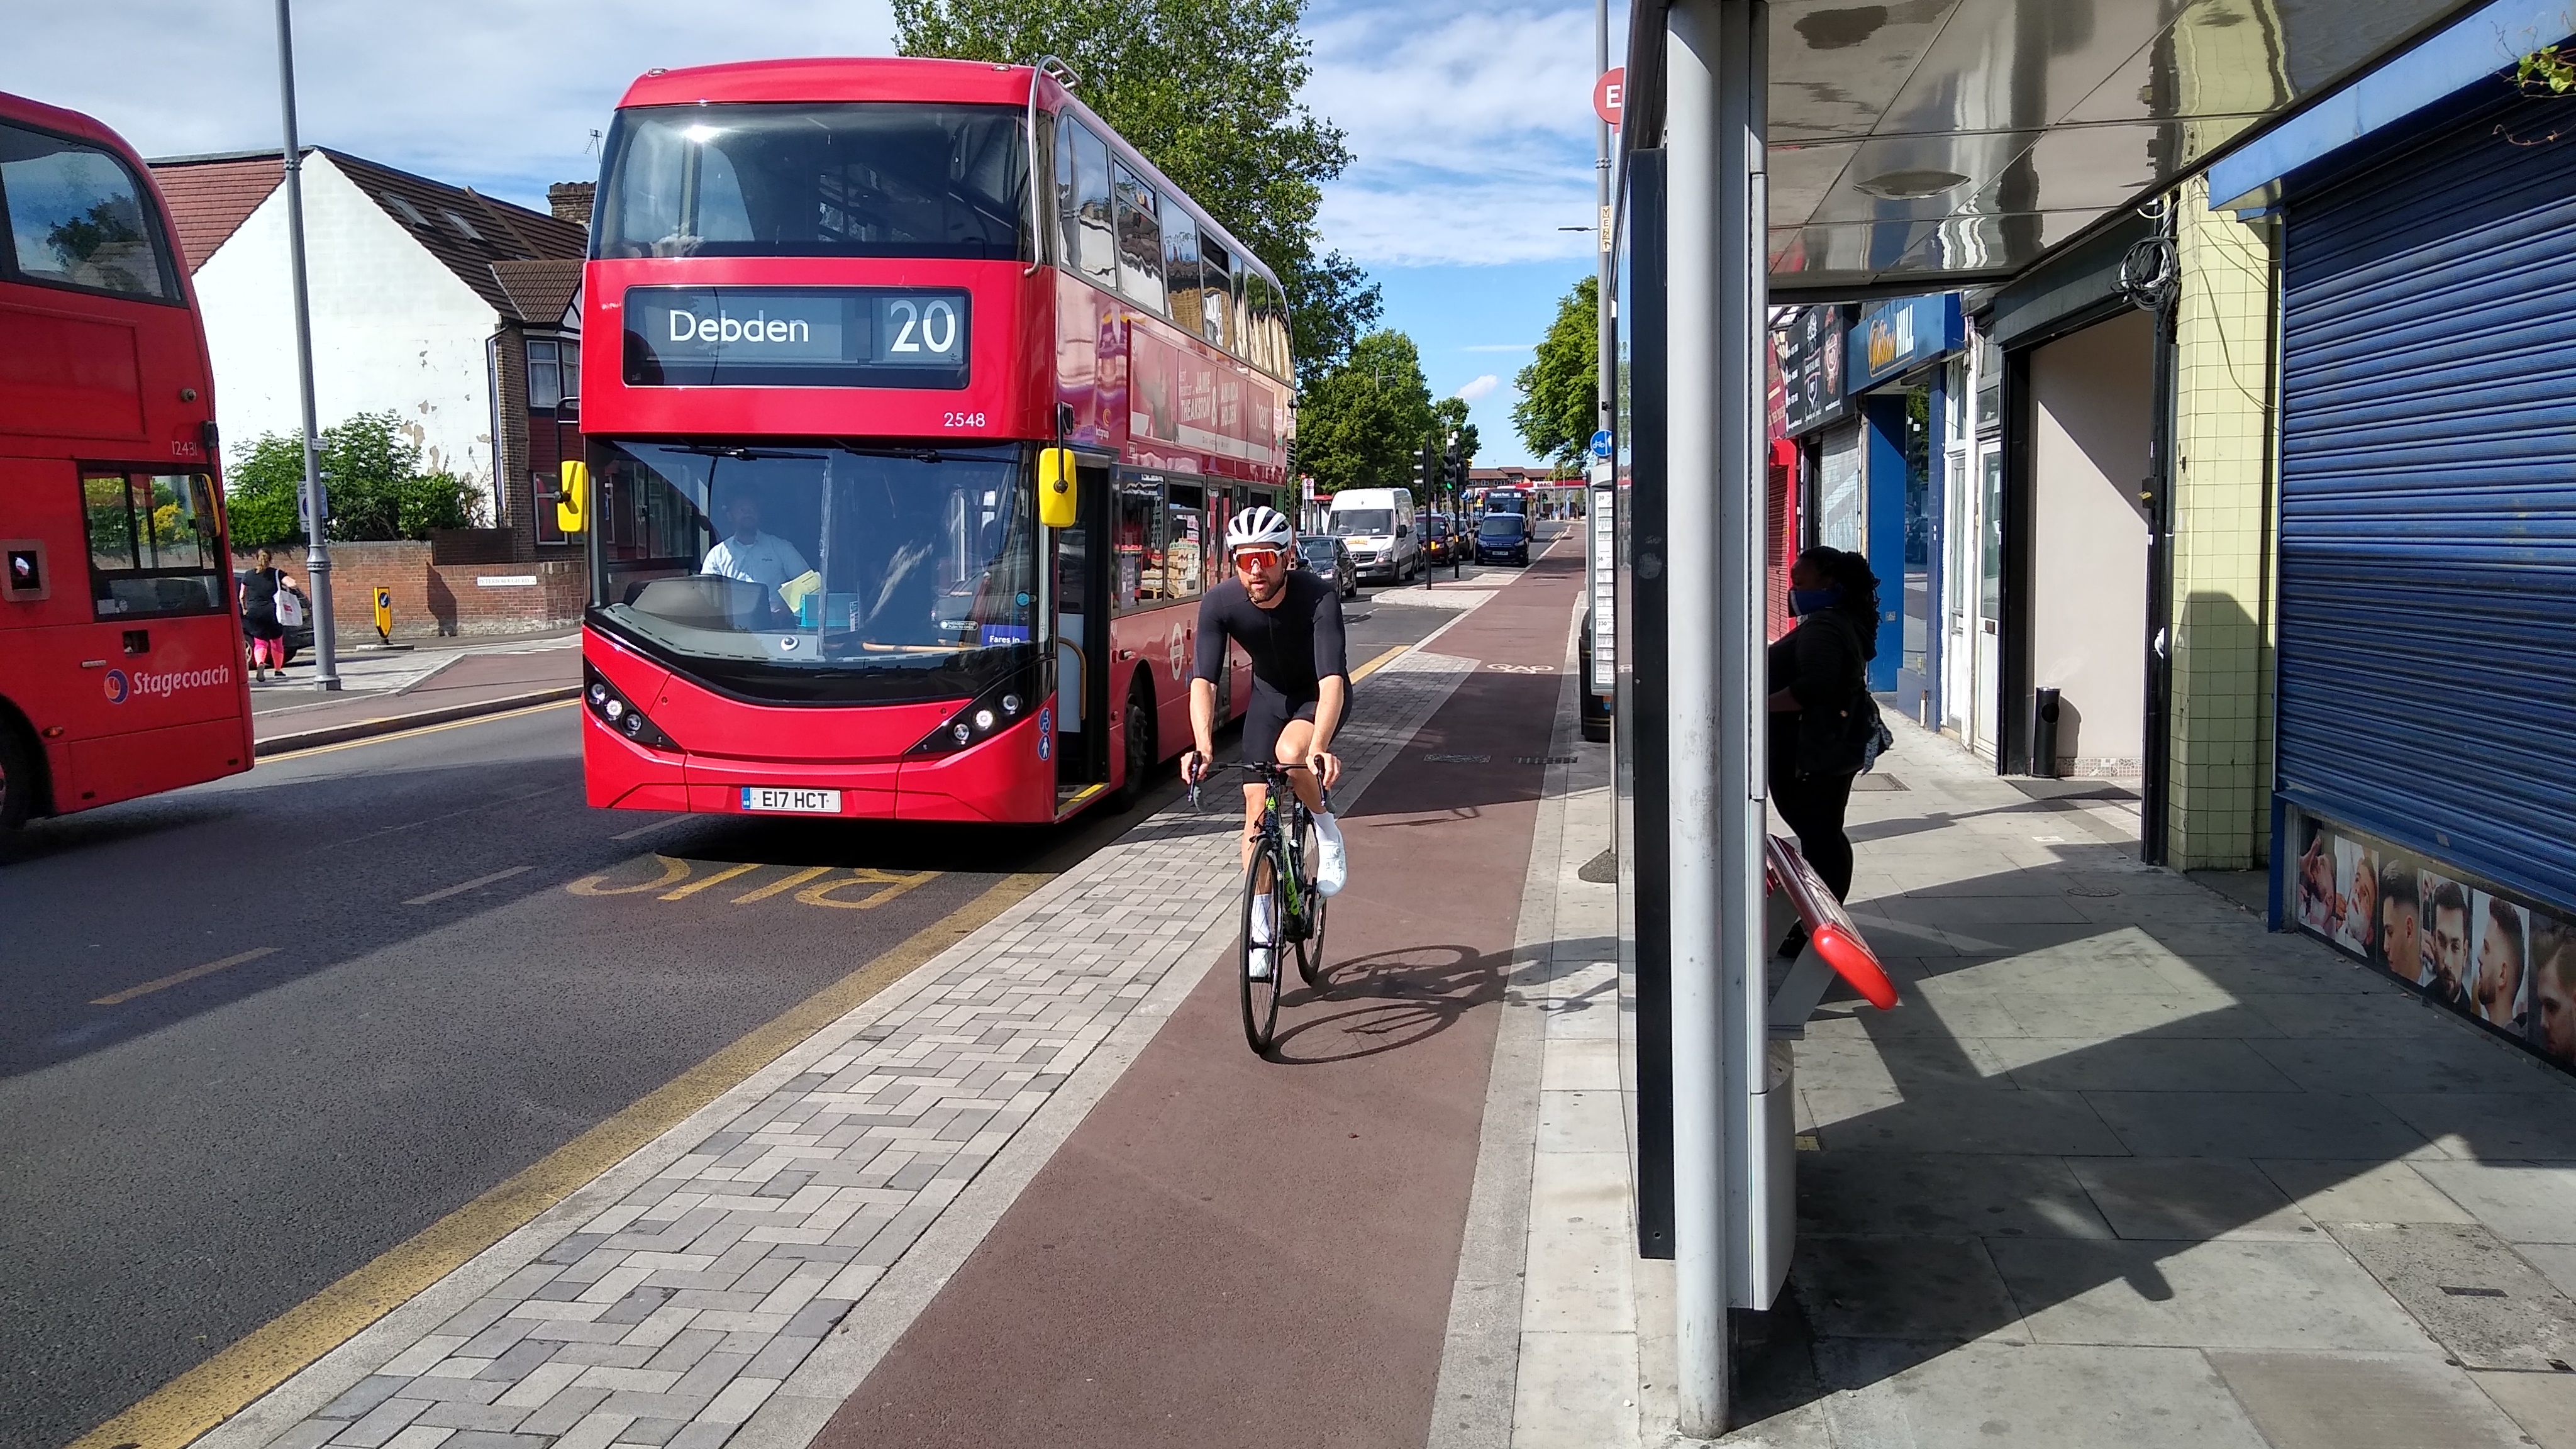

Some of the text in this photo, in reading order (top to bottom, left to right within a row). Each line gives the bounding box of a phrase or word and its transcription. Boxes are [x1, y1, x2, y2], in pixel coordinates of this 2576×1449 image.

[1606, 84, 1622, 108] E
[669, 299, 957, 353] Debden 20
[1896, 304, 1914, 358] HILL
[1196, 371, 1211, 394] JAMIE
[943, 413, 986, 427] 2548
[1180, 396, 1211, 422] THEAKSTON
[1256, 396, 1270, 431] heart
[172, 440, 198, 456] 12431
[989, 635, 1011, 643] Fares
[133, 664, 229, 697] Stagecoach
[762, 791, 828, 809] E17 HCT
